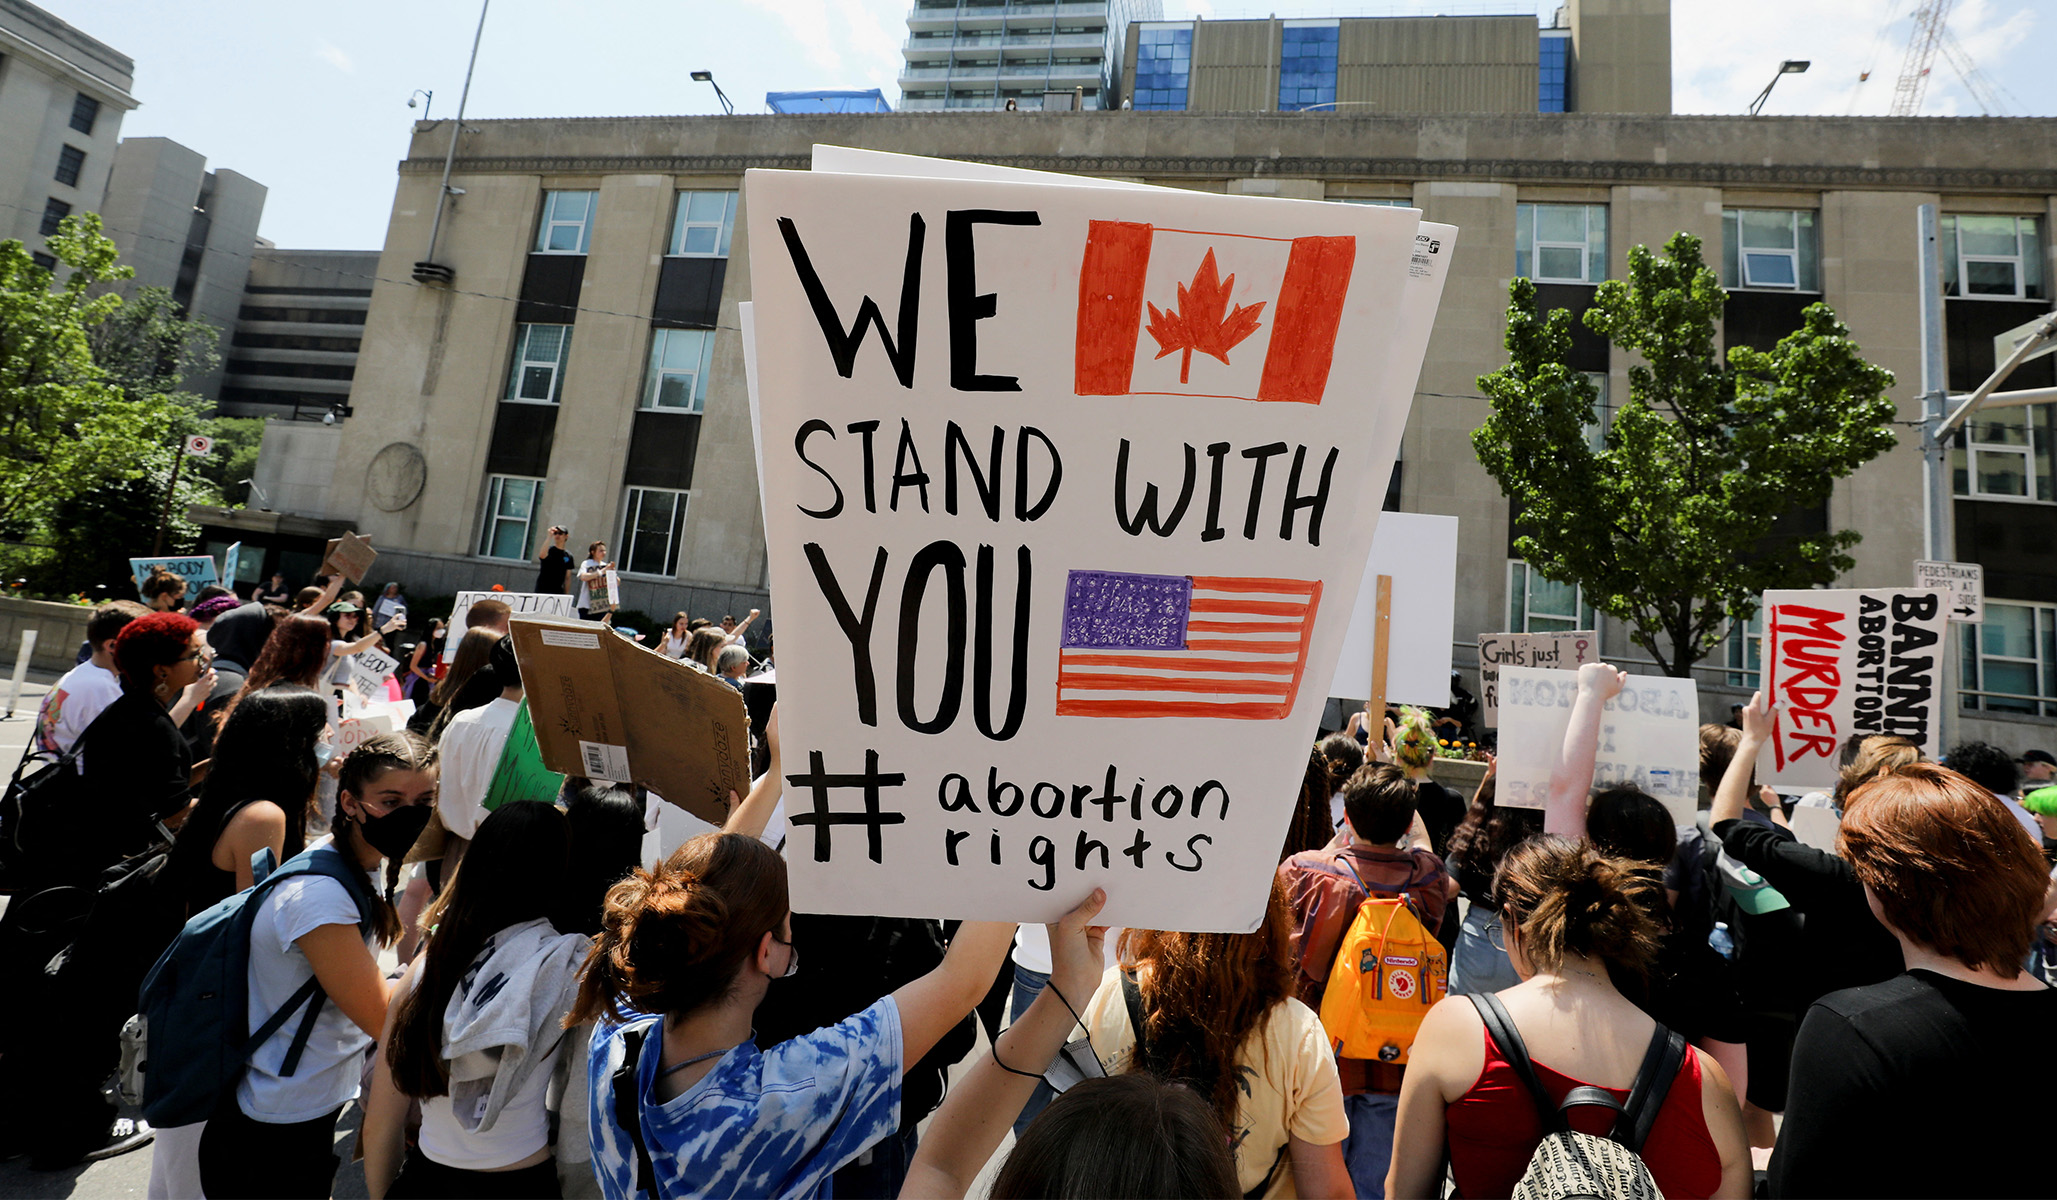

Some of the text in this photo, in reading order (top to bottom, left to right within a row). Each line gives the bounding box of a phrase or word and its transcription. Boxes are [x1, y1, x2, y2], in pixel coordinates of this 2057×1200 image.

[776, 209, 1041, 391] WE
[794, 417, 1340, 547] STAND WITH
[166, 560, 205, 576] BODY
[1958, 594, 1978, 606] SIDE
[1962, 581, 1974, 592] AT
[803, 539, 1032, 741] YOU
[1482, 639, 1560, 668] Girls just
[1779, 604, 1847, 763] MURDER
[785, 748, 1230, 864] # abortion
[945, 827, 1213, 892] rights
[1386, 957, 1416, 965] Nintendo
